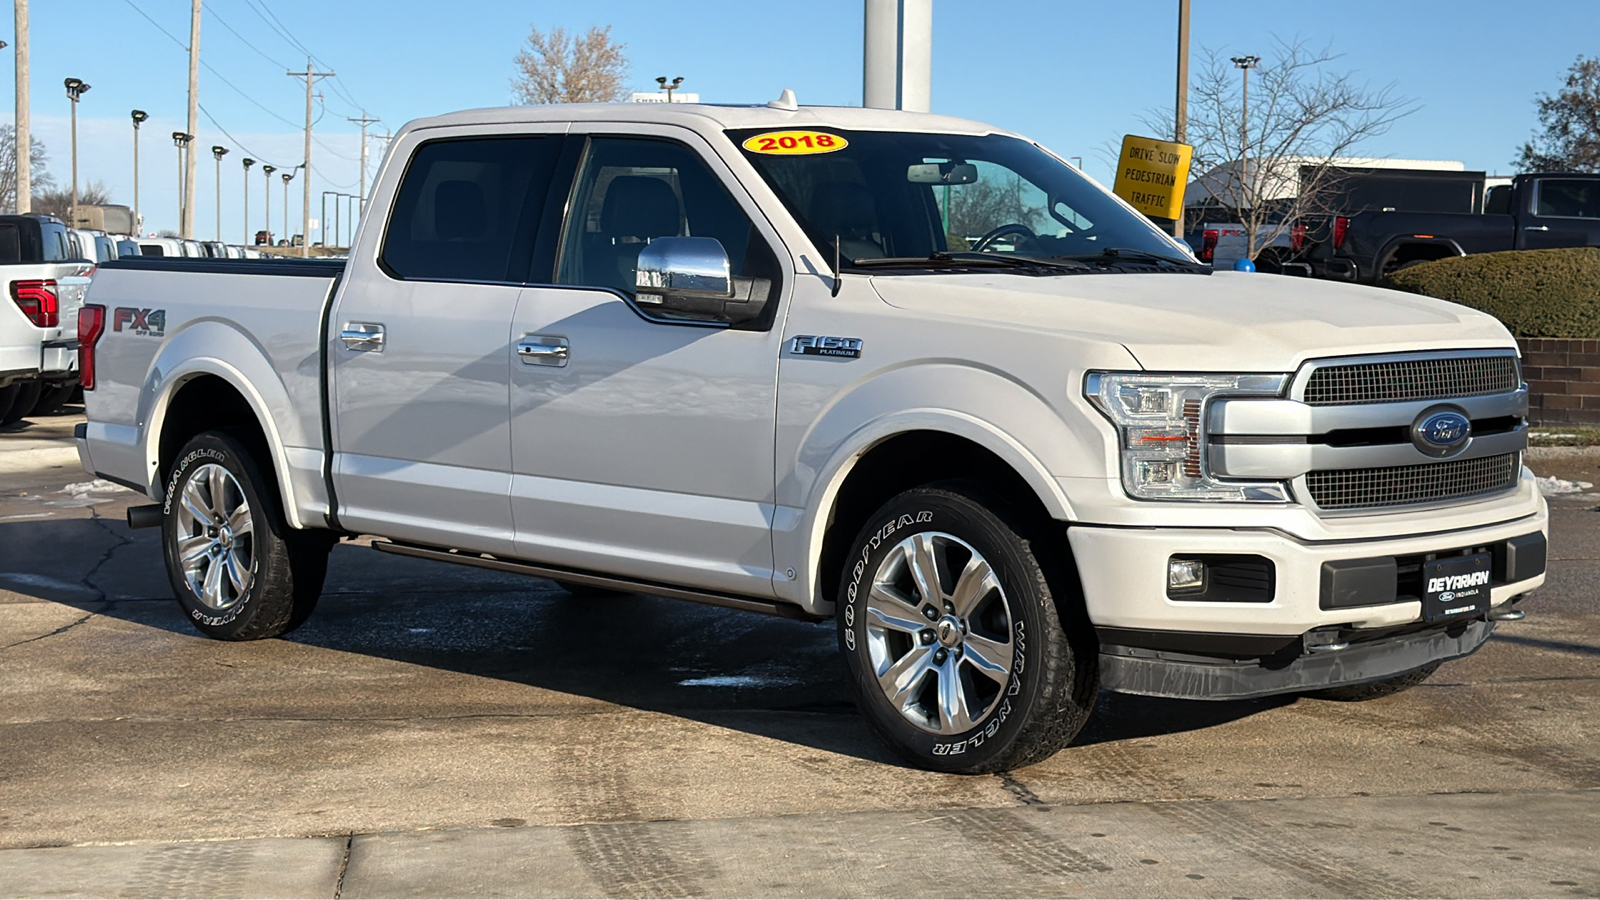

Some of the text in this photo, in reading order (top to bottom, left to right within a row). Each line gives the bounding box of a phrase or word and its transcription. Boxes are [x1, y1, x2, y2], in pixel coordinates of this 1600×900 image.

[758, 135, 835, 151] 2018
[1129, 147, 1181, 165] DRIVE SLOW
[1125, 168, 1176, 187] PEDESTRIAN
[1131, 191, 1166, 207] TRAFFIC
[113, 307, 166, 332] FX4
[1433, 420, 1461, 440] Ford
[164, 449, 226, 515] WRANGLER
[845, 511, 934, 651] GOODYEAR
[1427, 570, 1490, 593] DEYARMAN
[932, 620, 1025, 756] WRANGLER
